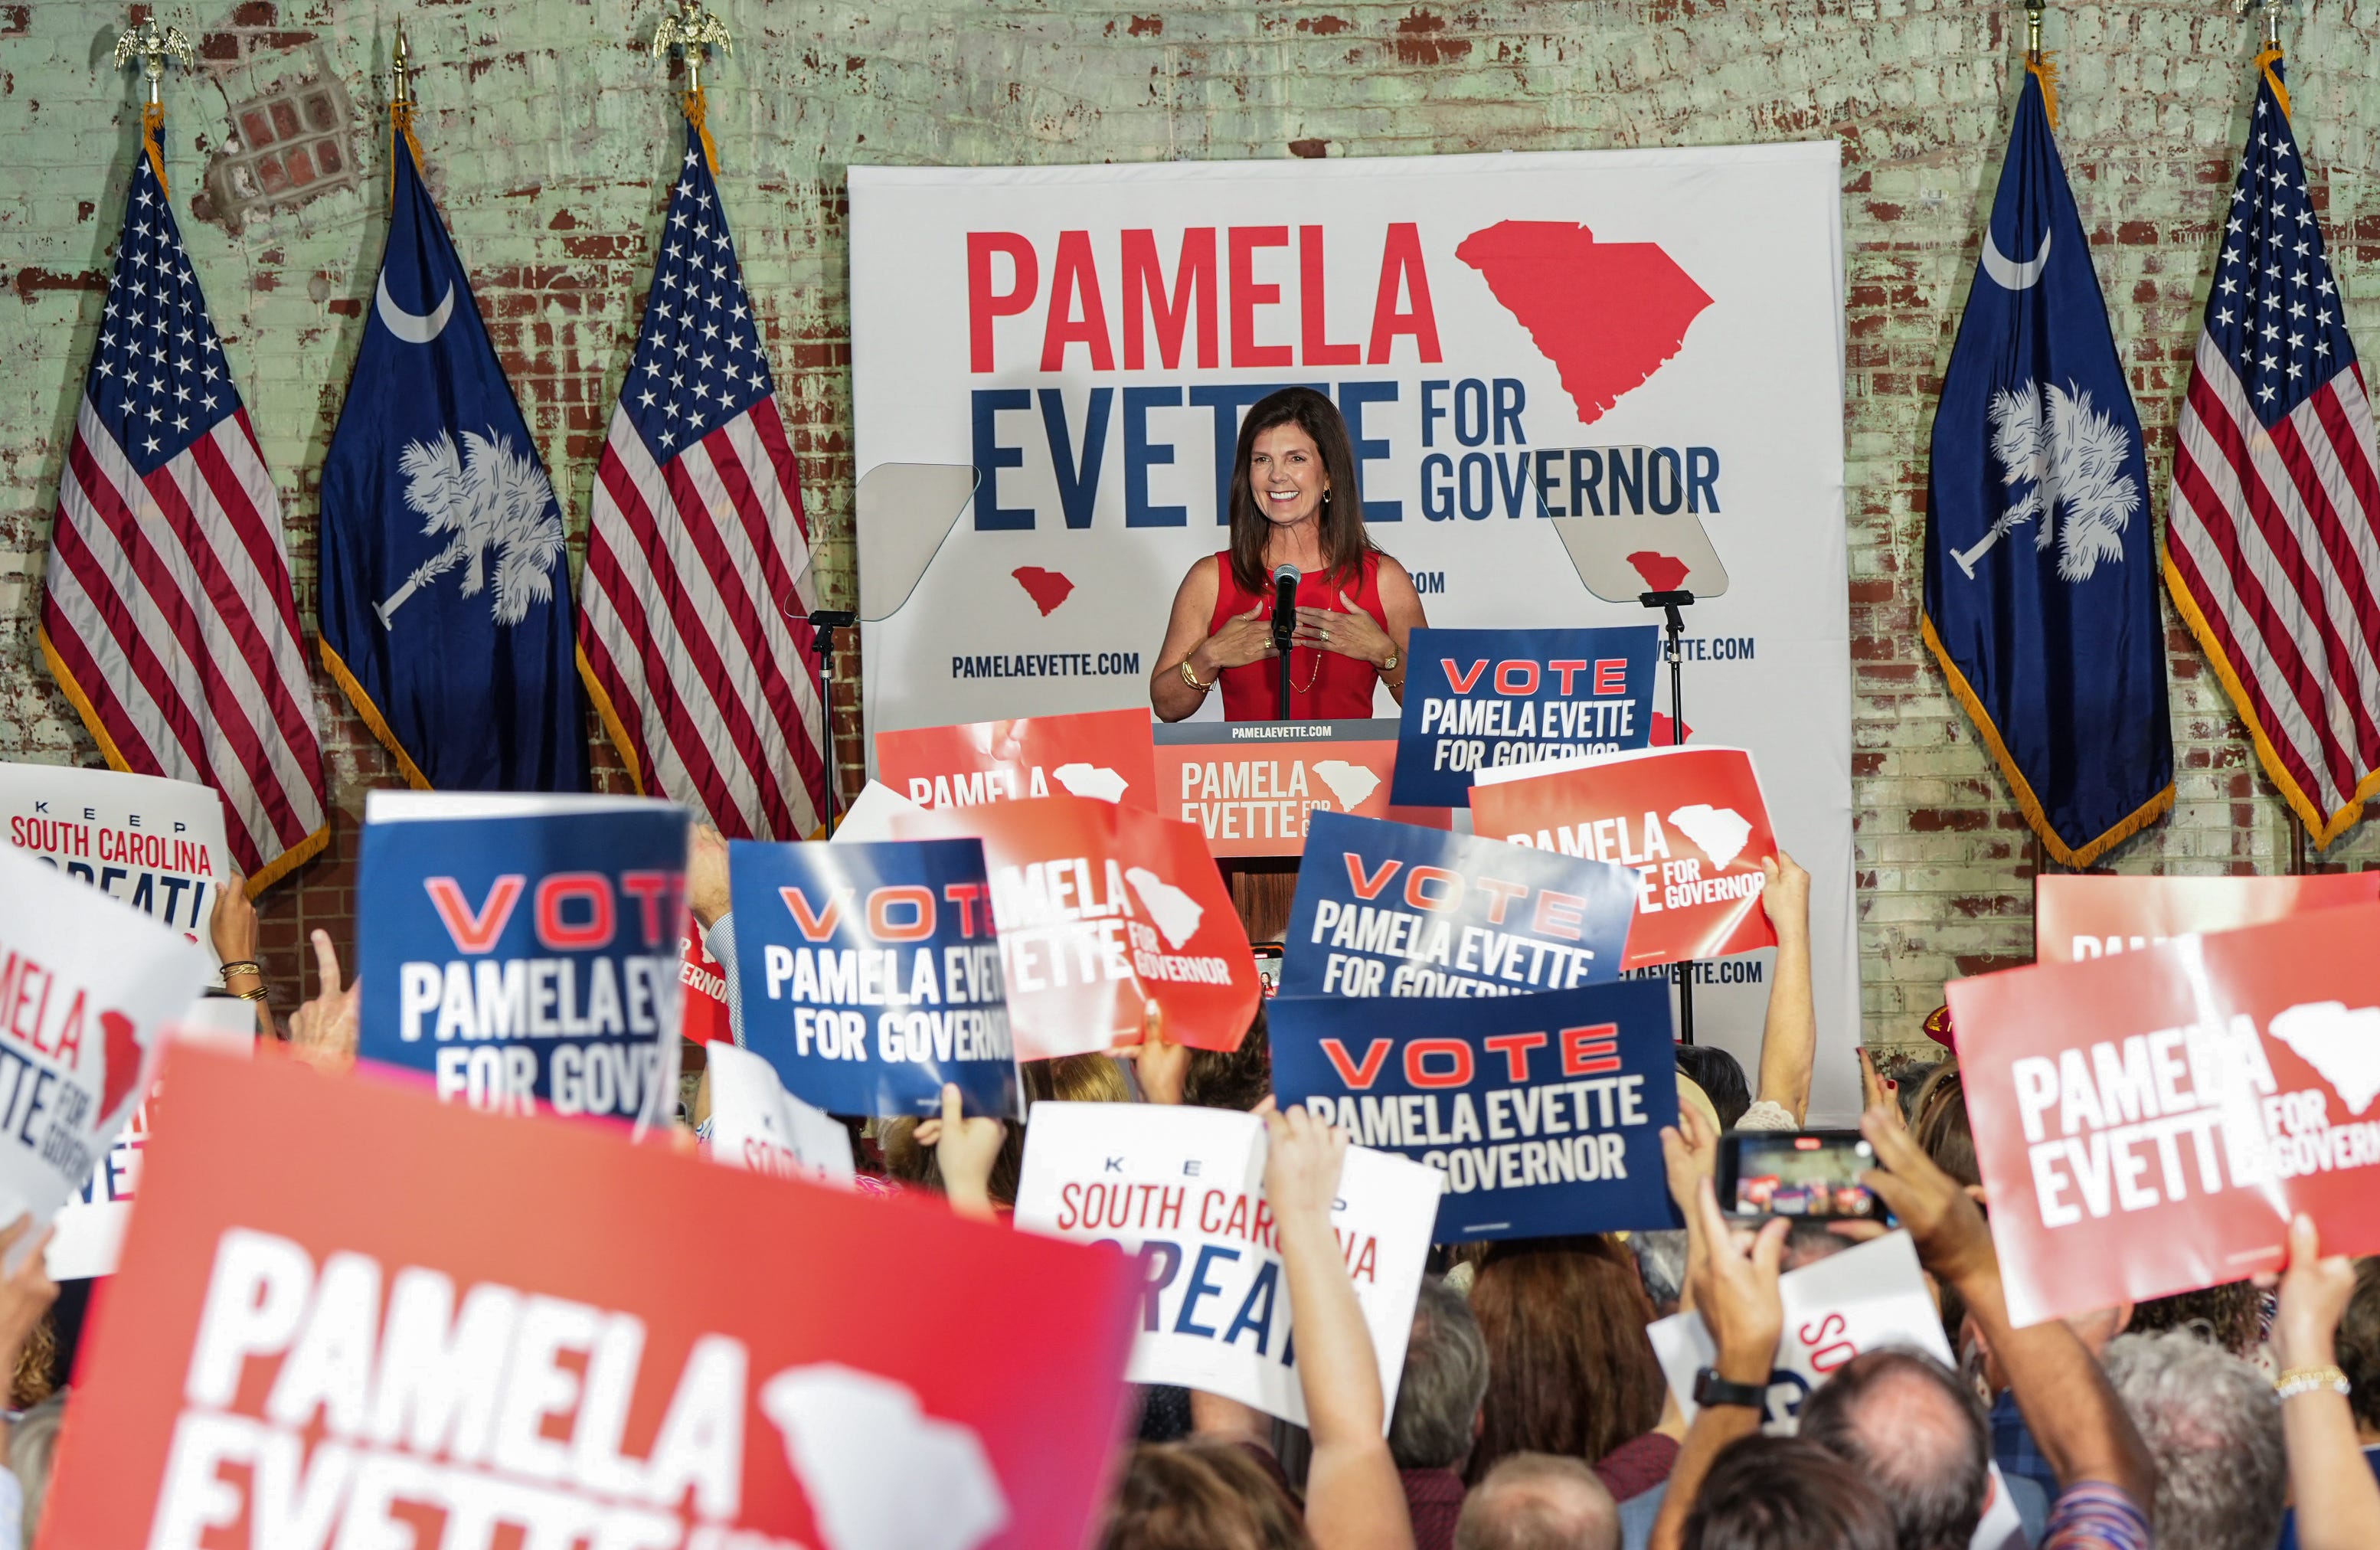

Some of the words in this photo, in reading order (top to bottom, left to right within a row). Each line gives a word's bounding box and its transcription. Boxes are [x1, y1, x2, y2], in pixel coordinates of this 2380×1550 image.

[966, 222, 1443, 373] PAMELA
[1420, 378, 1526, 447] FOR
[971, 381, 1403, 531] EVETE
[1420, 446, 1721, 522] GOVERNOR
[952, 652, 1139, 679] PAMELAEVETTE.COM
[1440, 659, 1628, 695] VOTE
[1231, 726, 1332, 738] PAMELAEVETTE.COM
[1420, 698, 1537, 737] PAMELA
[1541, 699, 1636, 738] EVETTE
[1182, 760, 1309, 800] PAMELA
[1434, 739, 1486, 772] FOR
[35, 801, 186, 833] KEEP
[1182, 800, 1298, 839] EVETTE
[1507, 811, 1670, 865] MELA
[11, 816, 90, 858] SOUTH
[99, 828, 213, 877] CAROLINA
[1662, 858, 1702, 886] FOR
[995, 857, 1133, 930] MELA
[1343, 852, 1587, 940] VOTE
[998, 918, 1134, 993] ETTE
[1127, 921, 1161, 954] FOR
[1311, 899, 1450, 966] PAMELA
[1456, 925, 1594, 989] EVETTE
[764, 944, 940, 1006] PAMELA
[1133, 949, 1233, 986] GOVERNOR
[1322, 953, 1385, 998] FOR
[399, 956, 625, 1042] PAMELA
[793, 1007, 868, 1062] FOR
[1319, 1022, 1621, 1090] VOTE
[1306, 1093, 1482, 1146] PAMELA
[1486, 1074, 1648, 1140] EVETTE
[2262, 1088, 2330, 1137] FOR
[1424, 1133, 1627, 1195] GOVERNOR
[2267, 1119, 2380, 1179] GOVERN
[1058, 1183, 1185, 1230] SOUTH
[182, 1224, 750, 1524] PAMELA
